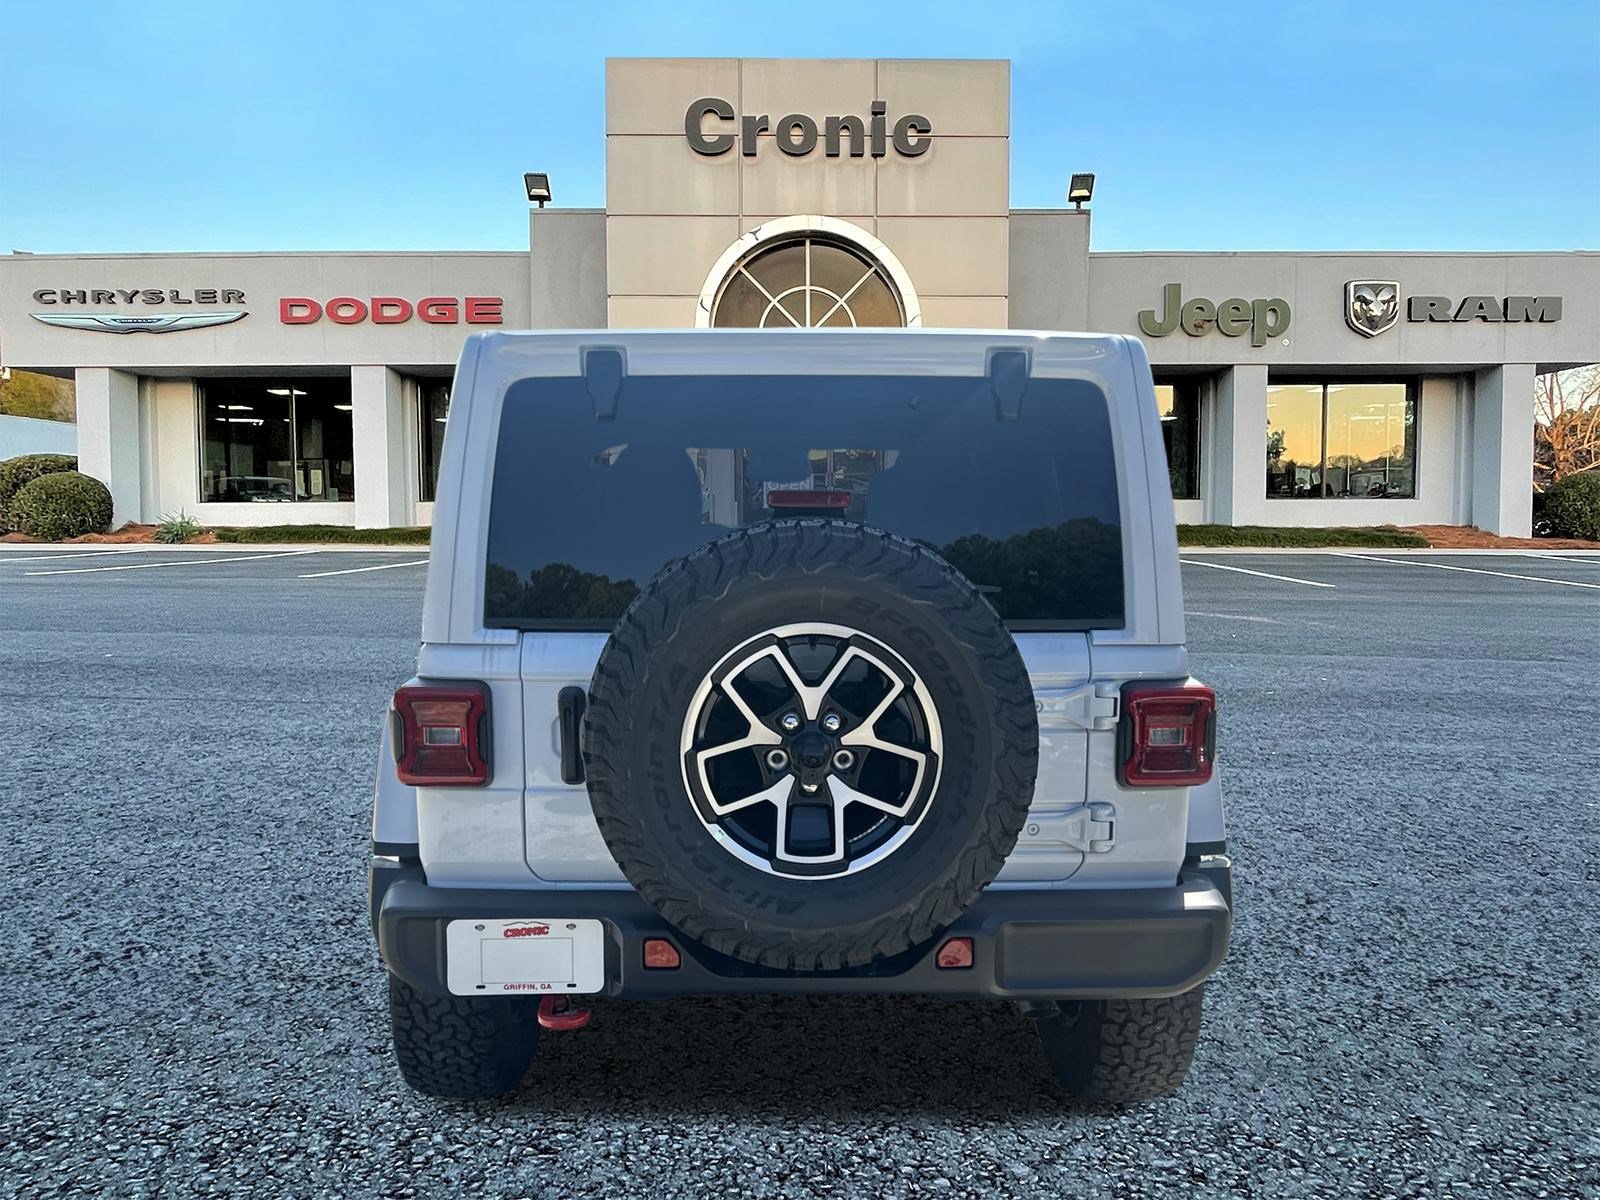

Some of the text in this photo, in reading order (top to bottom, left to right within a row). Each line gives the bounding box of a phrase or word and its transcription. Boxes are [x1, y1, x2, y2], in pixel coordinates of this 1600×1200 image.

[685, 97, 932, 158] Cronic
[32, 289, 247, 305] CHRYSLER
[279, 297, 504, 324] DODGE
[1407, 296, 1564, 323] RAM
[1138, 283, 1291, 347] Jeep
[503, 926, 550, 938] CRONIC
[503, 983, 538, 991] GRIFFIN,
